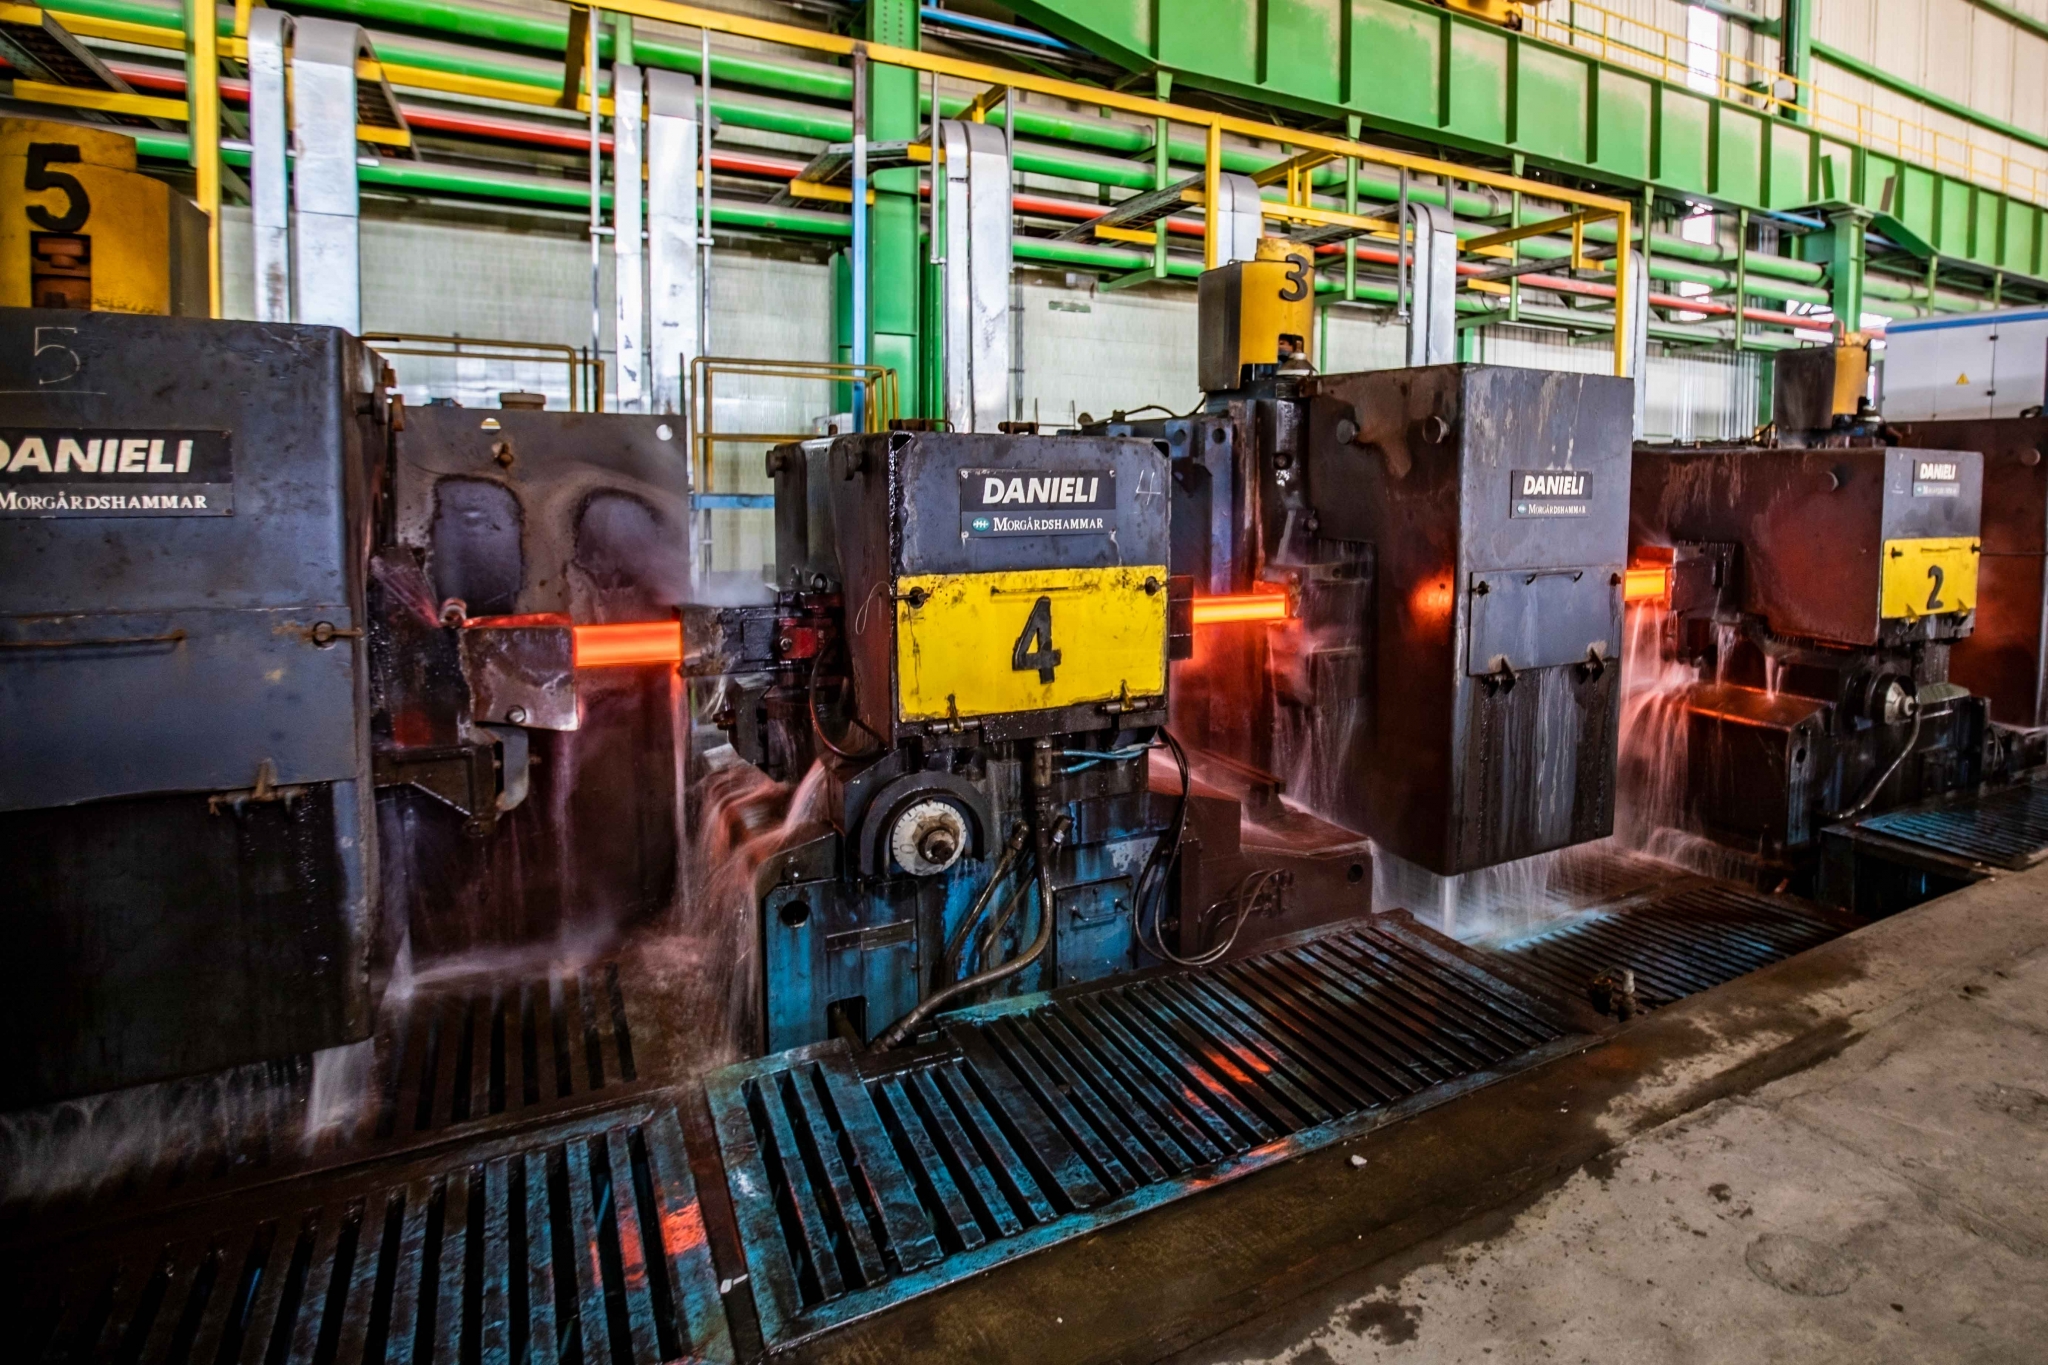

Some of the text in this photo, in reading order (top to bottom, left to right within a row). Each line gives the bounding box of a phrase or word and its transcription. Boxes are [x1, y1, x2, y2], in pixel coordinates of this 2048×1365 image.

[25, 142, 91, 232] 5
[1279, 253, 1309, 302] 3
[34, 326, 81, 385] 5
[0, 437, 194, 473] ANIELI
[1920, 462, 1957, 480] DANIELI
[982, 477, 1099, 504] DANIELI
[1135, 469, 1162, 505] 4
[1523, 475, 1585, 495] DANIELI
[993, 516, 1104, 532] MORGÅRDSHAMMAR
[1926, 565, 1944, 610] 2
[1011, 596, 1062, 685] 4
